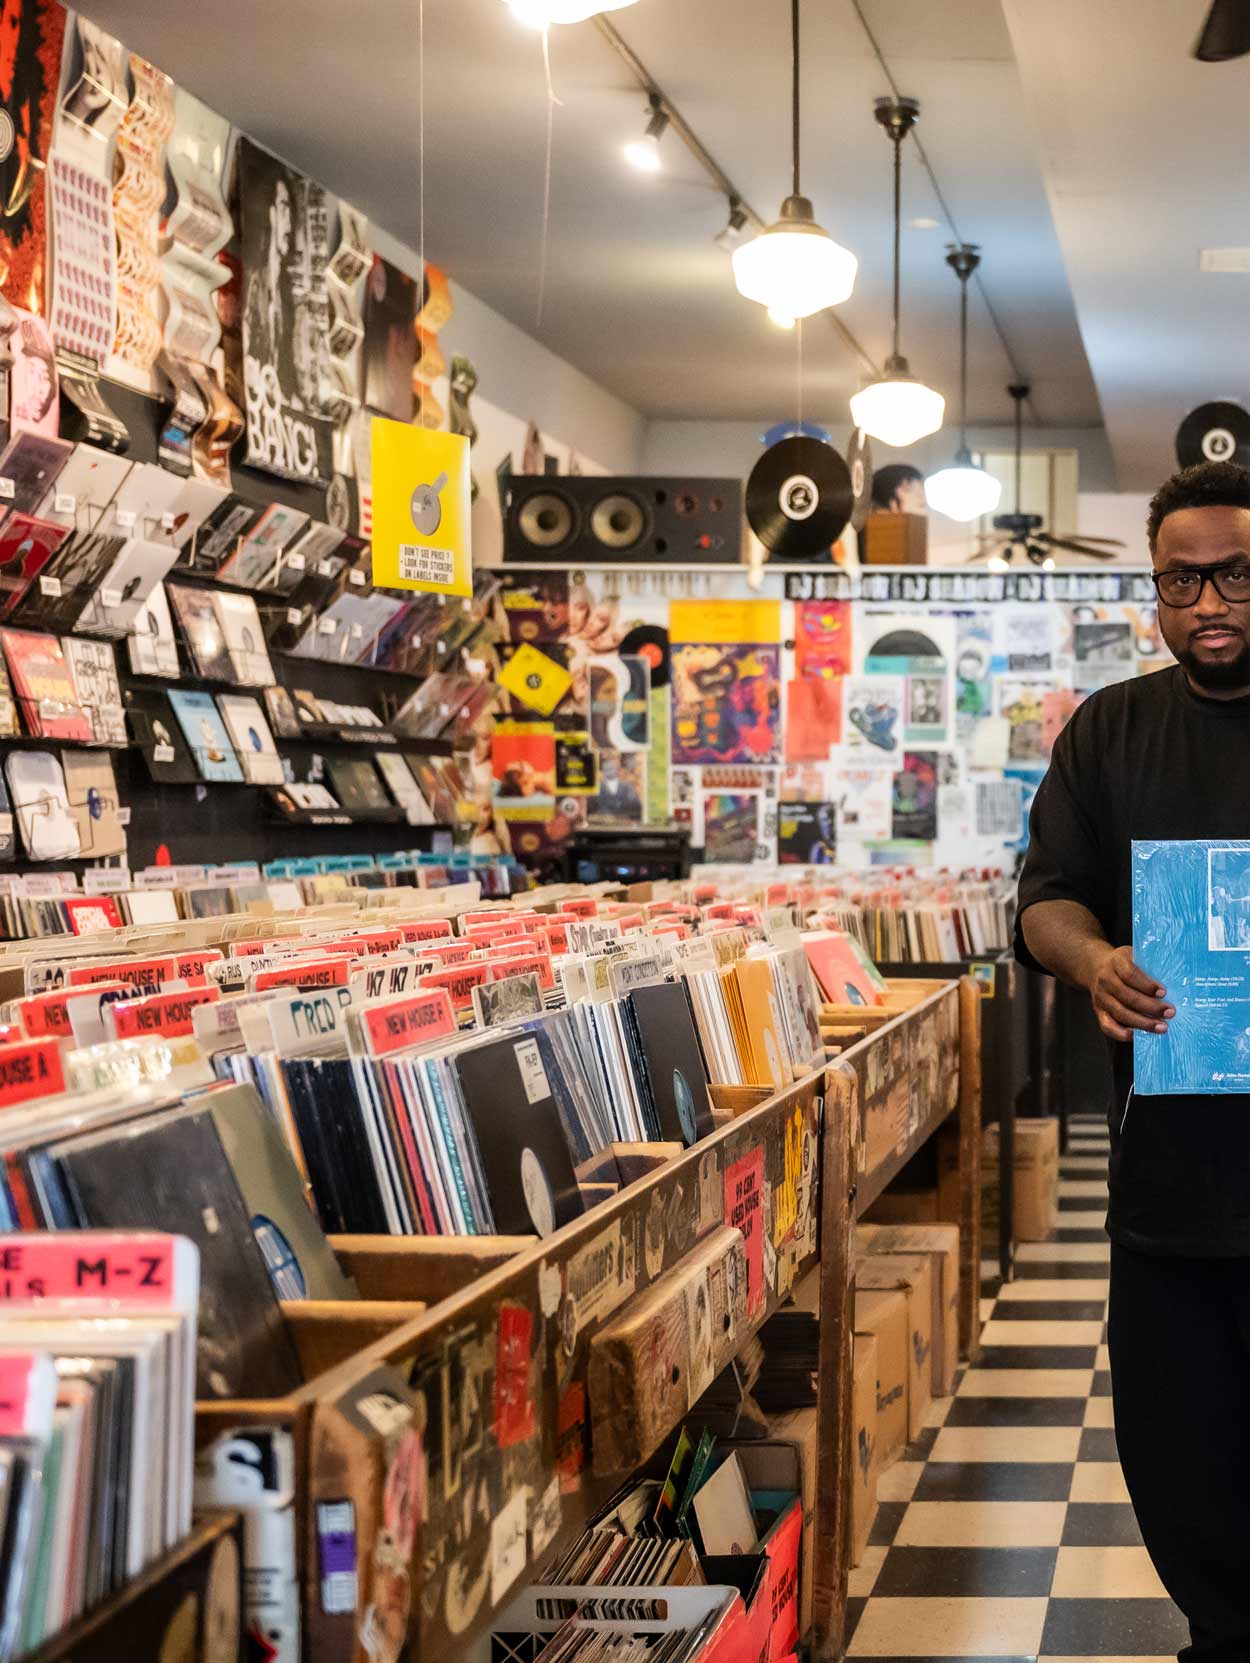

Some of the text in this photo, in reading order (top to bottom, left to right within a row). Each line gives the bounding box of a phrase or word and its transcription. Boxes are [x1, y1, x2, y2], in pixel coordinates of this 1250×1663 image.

[135, 1006, 163, 1031] NEW
[385, 1013, 407, 1035] NEW
[408, 1004, 436, 1031] HOUSE
[77, 1256, 163, 1287] M-Z
